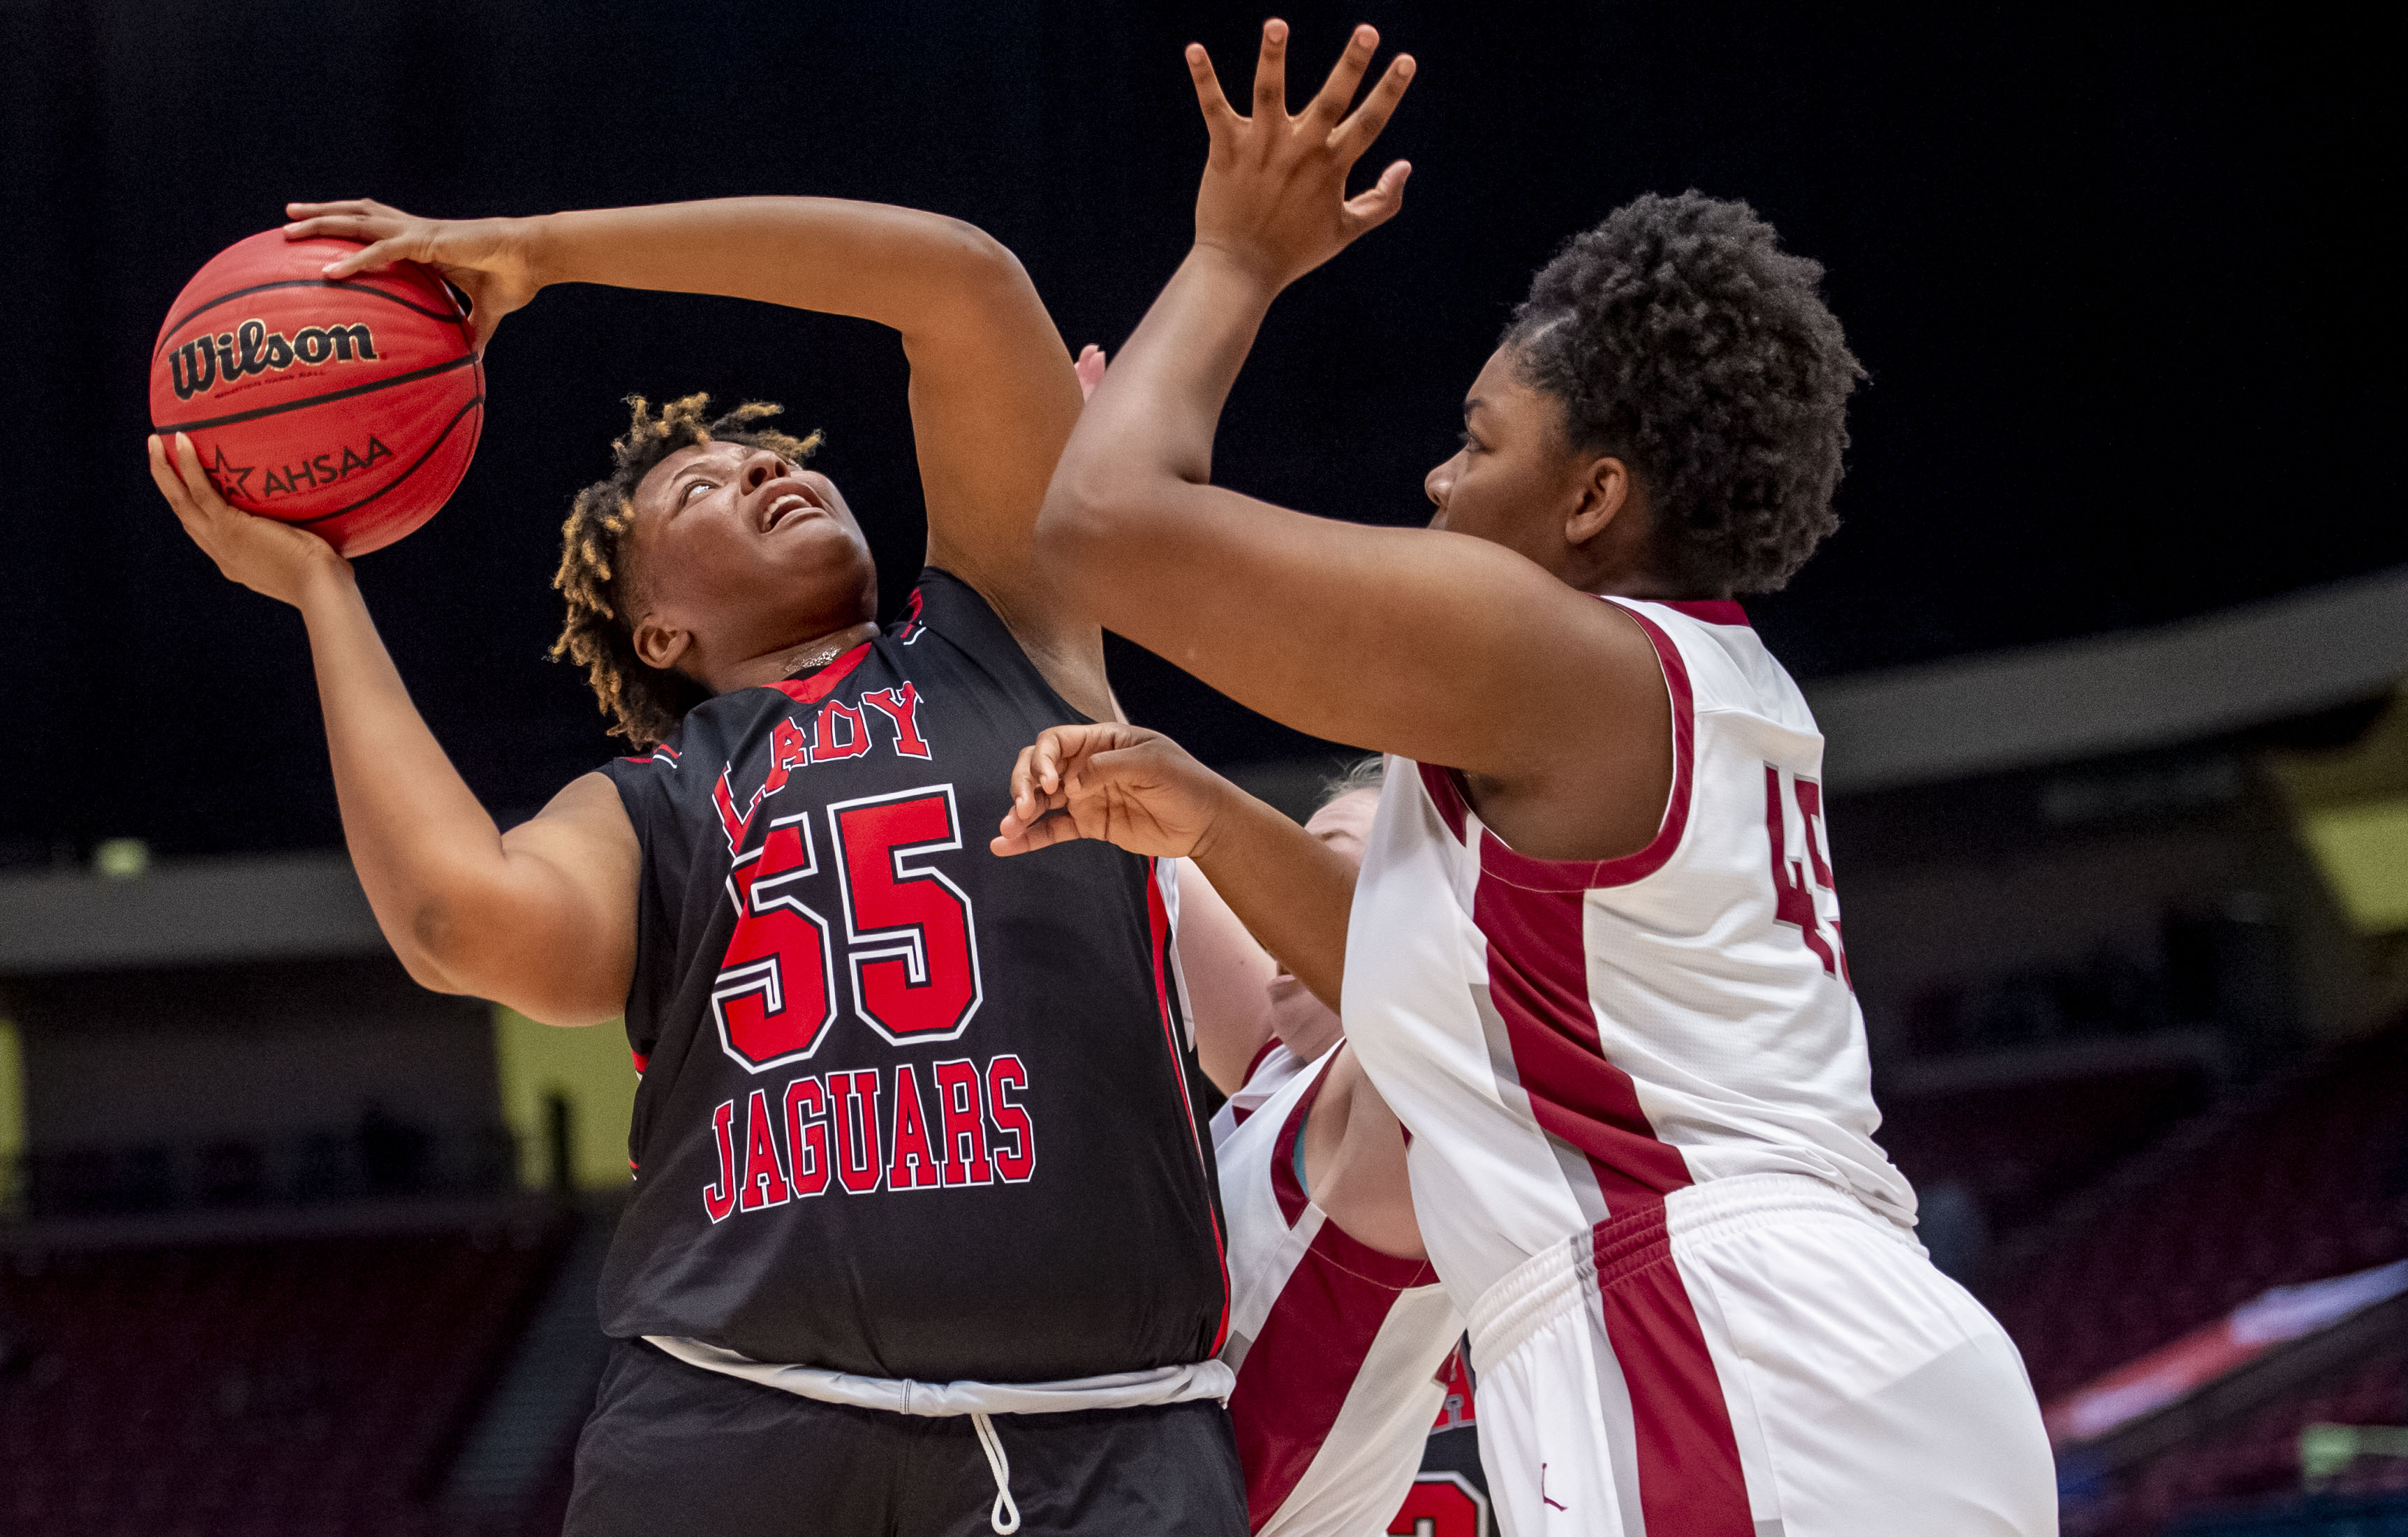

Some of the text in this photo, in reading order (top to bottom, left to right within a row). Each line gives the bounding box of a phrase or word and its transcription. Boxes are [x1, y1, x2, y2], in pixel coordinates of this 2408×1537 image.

[168, 318, 379, 401] Wilson
[263, 435, 393, 496] AHSAA
[711, 681, 932, 859] LADY
[711, 783, 983, 1074] 55
[703, 1054, 1036, 1224] JAGUARS
